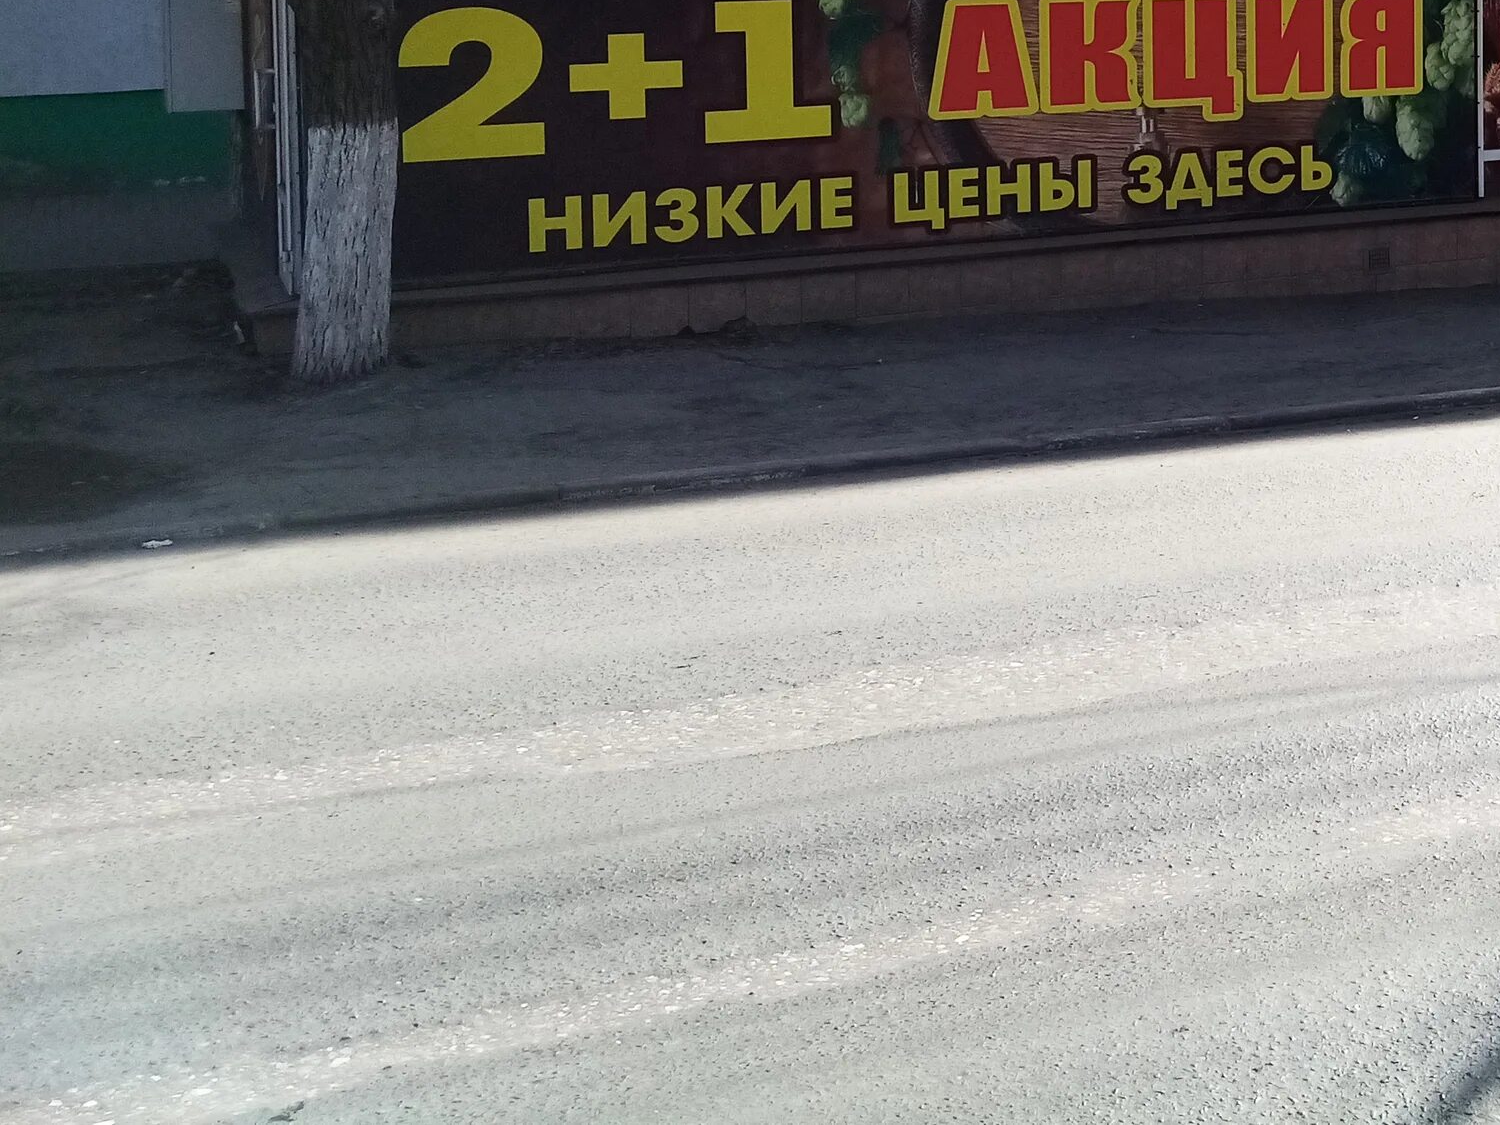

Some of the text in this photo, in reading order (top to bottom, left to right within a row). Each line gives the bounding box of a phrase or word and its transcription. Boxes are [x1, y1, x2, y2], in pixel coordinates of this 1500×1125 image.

[398, 0, 832, 163] 2+1
[528, 145, 1333, 253] НИЗКИЕ ЦЕНЫ ЗДЕСЬ
